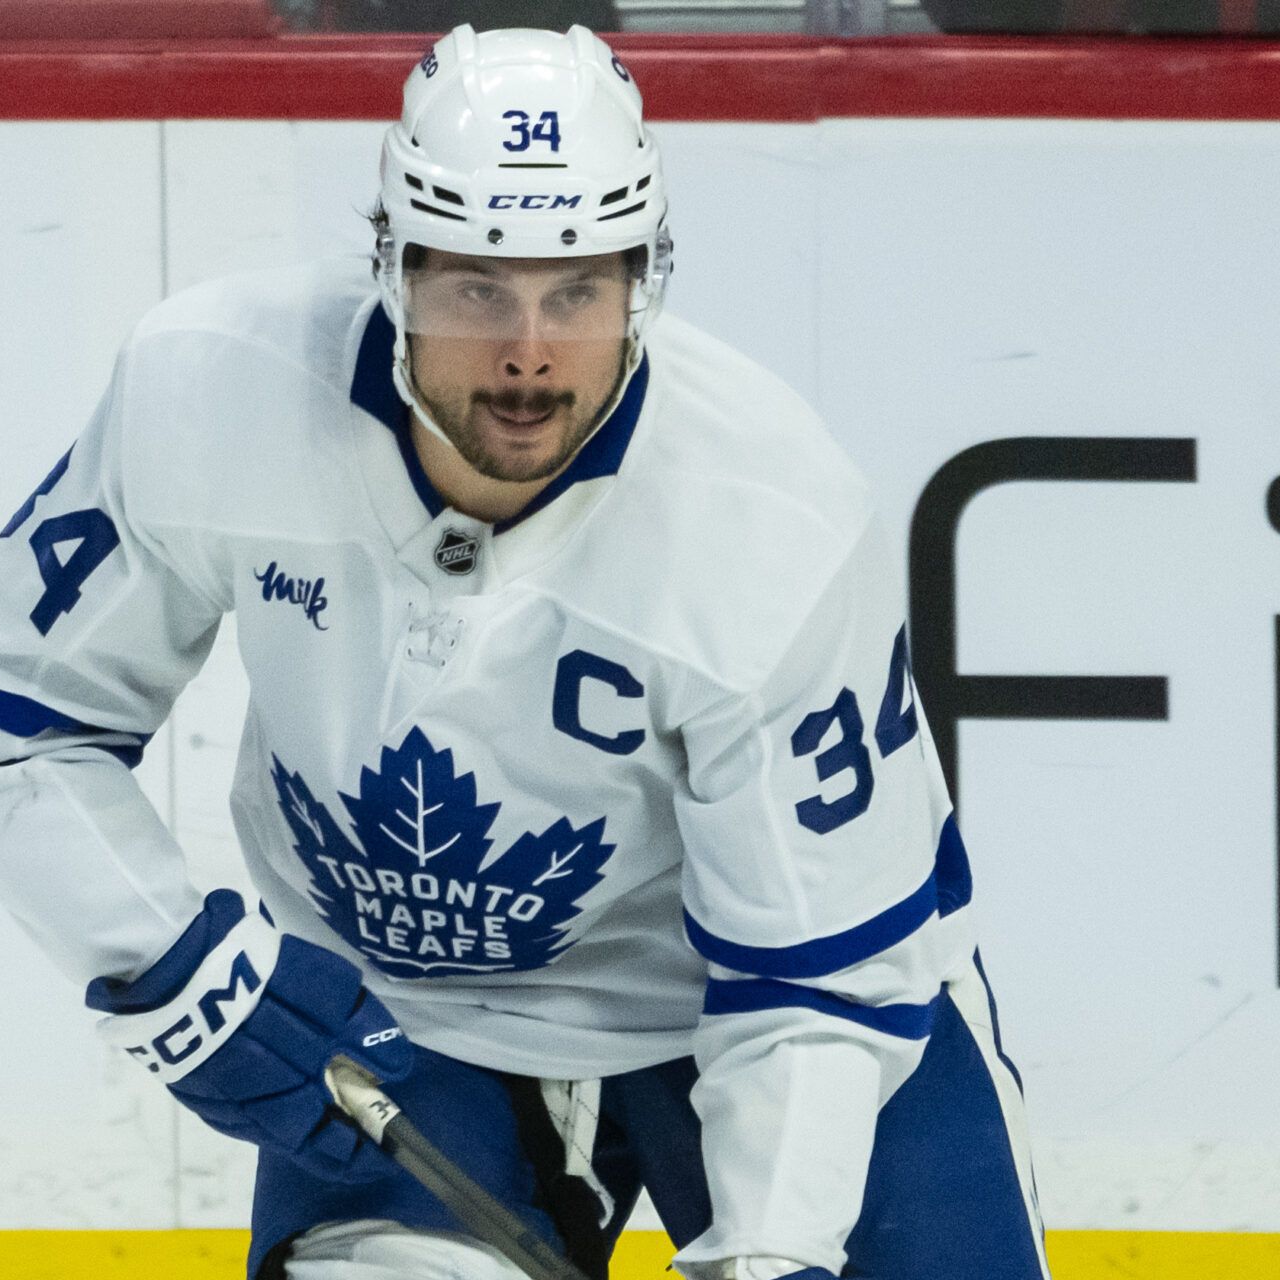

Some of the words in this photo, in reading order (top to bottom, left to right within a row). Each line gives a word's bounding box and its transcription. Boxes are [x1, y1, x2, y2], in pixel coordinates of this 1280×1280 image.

[502, 110, 561, 152] 34
[487, 194, 583, 210] CCM
[441, 545, 472, 563] NHL
[551, 649, 646, 756] C
[317, 854, 545, 922] TORONTO
[354, 891, 509, 940] MAPLE
[358, 916, 513, 959] LEAFS
